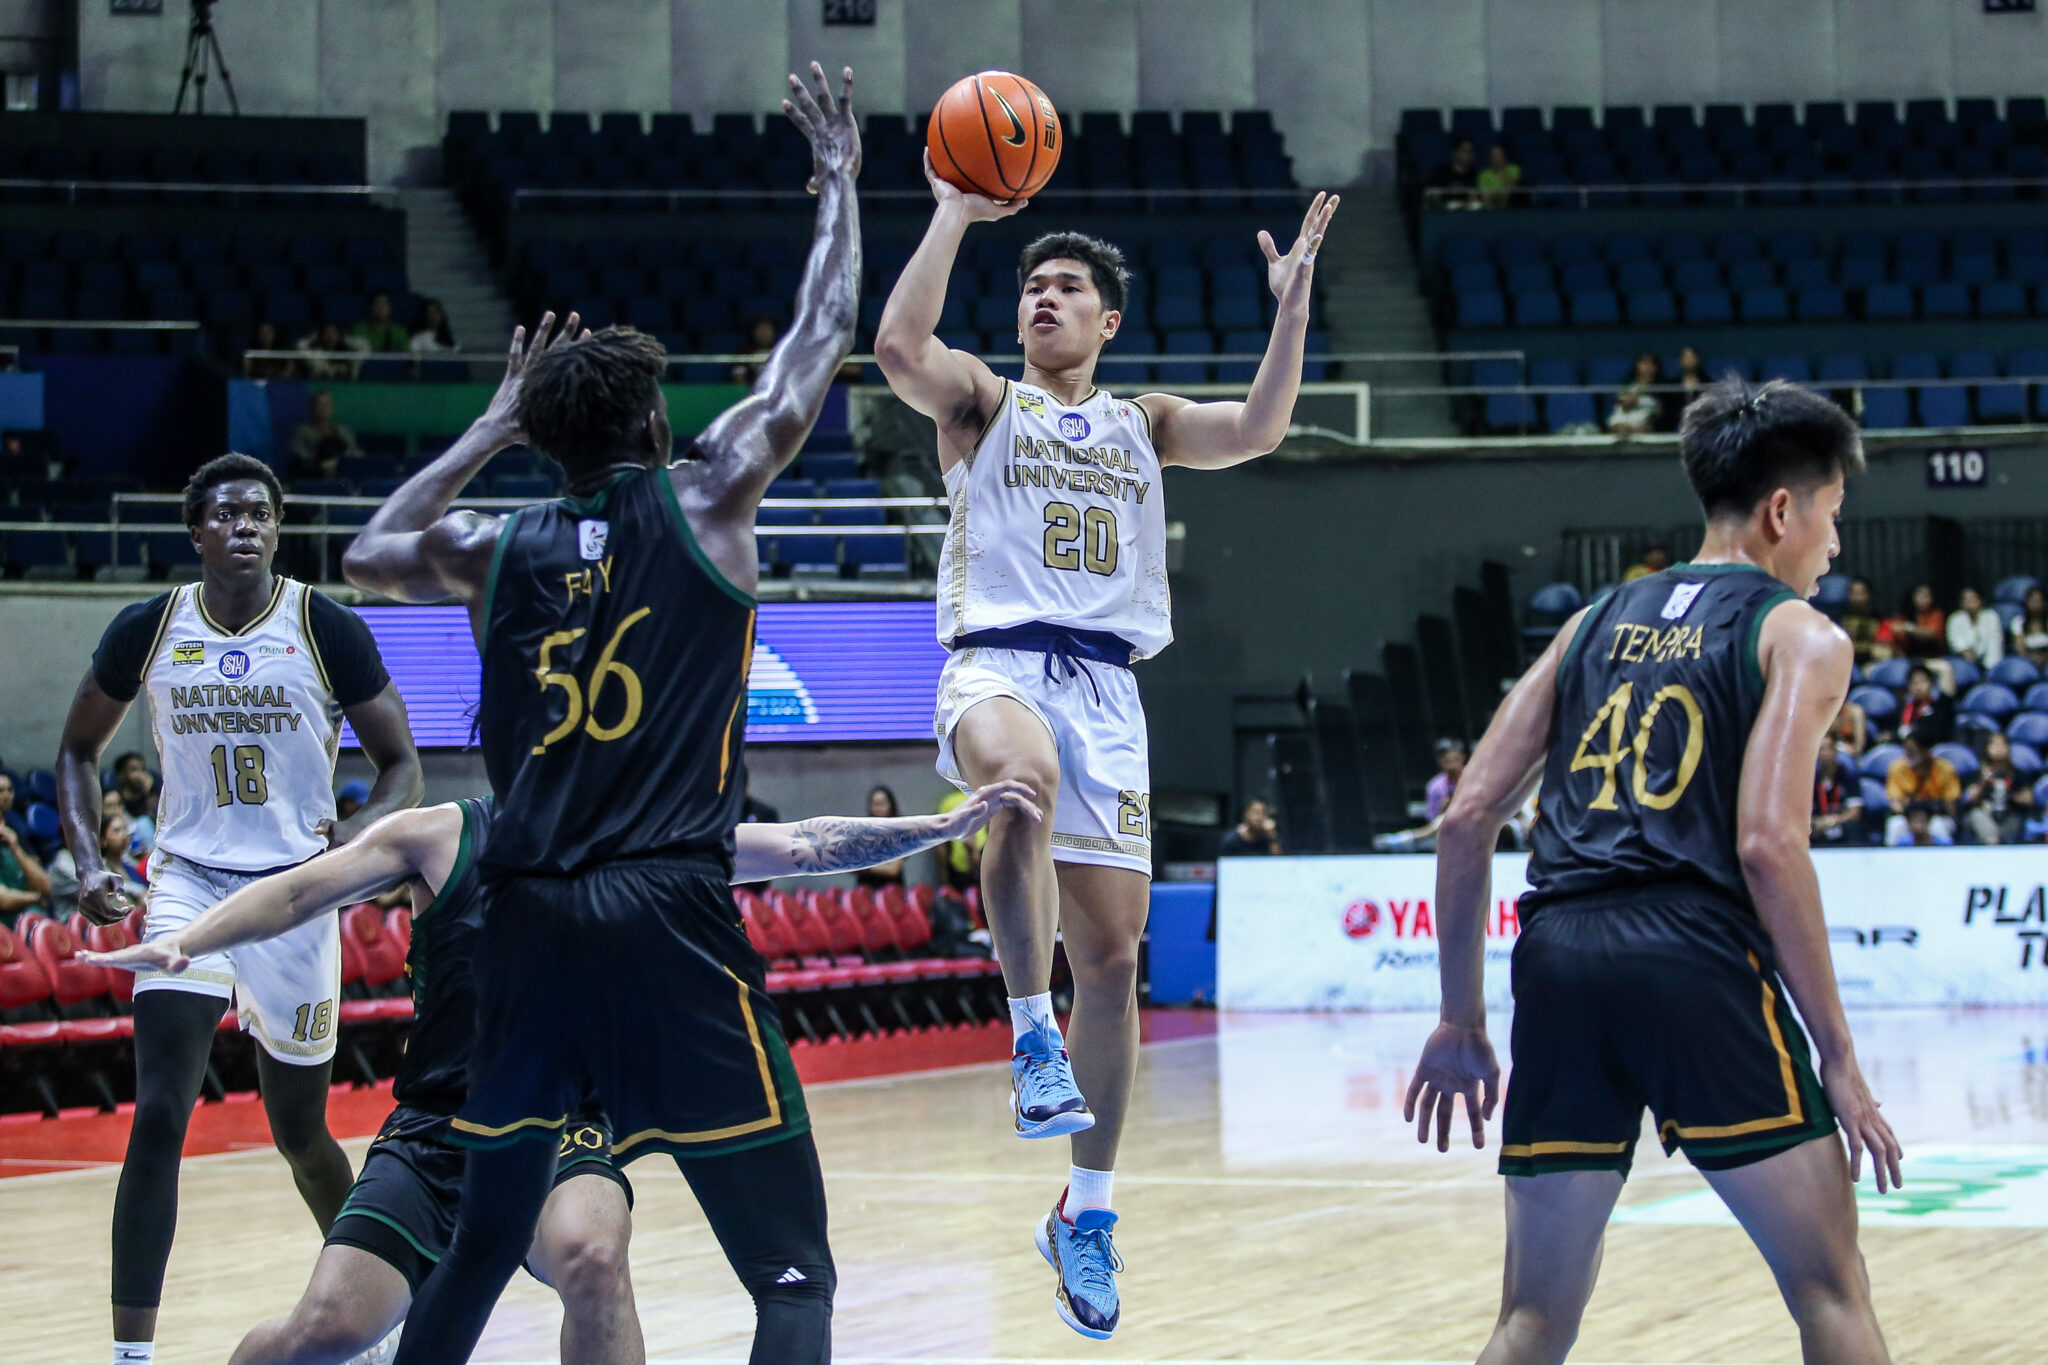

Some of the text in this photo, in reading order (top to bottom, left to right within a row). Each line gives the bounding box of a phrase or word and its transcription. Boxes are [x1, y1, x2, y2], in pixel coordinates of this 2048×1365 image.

[1015, 435, 1139, 474] NATIONAL
[1930, 451, 1983, 481] 110
[1004, 465, 1150, 504] UNIVERSITY
[1043, 501, 1119, 577] 20
[171, 685, 291, 709] NATIONAL
[531, 606, 651, 756] 56
[171, 712, 302, 734] UNIVERSITY
[1570, 682, 1704, 811] 40
[211, 745, 268, 807] 18
[292, 999, 332, 1041] 18
